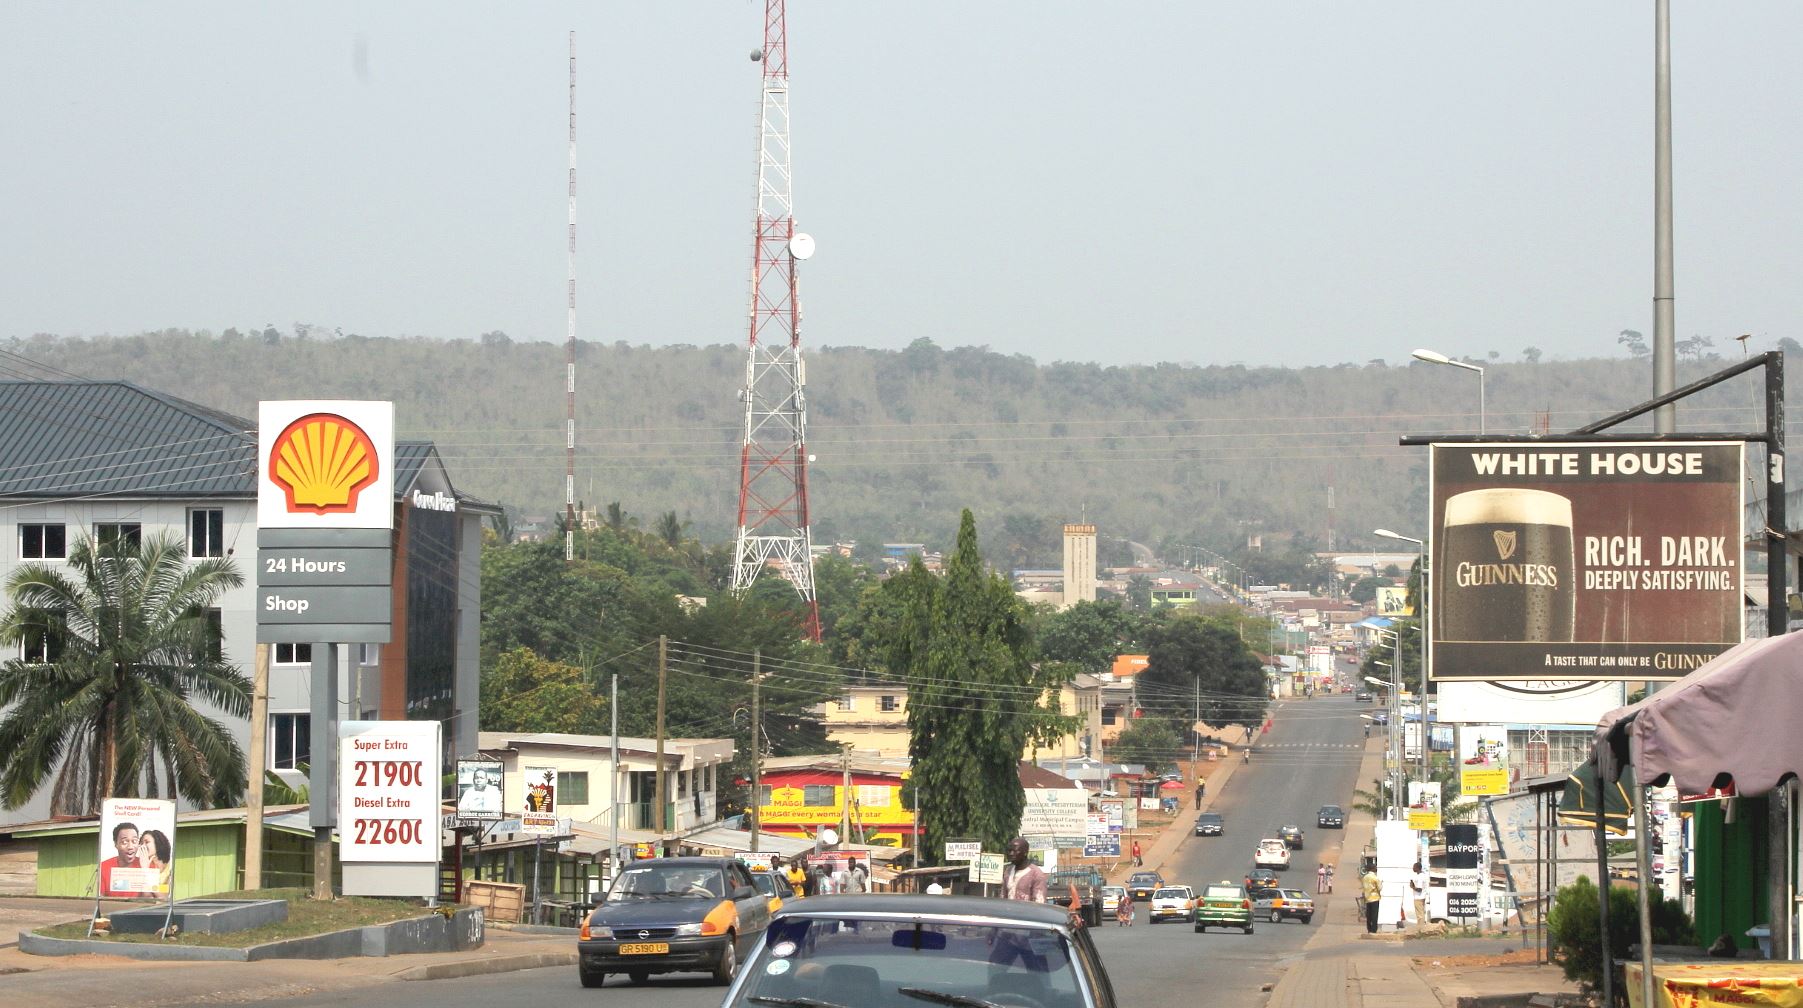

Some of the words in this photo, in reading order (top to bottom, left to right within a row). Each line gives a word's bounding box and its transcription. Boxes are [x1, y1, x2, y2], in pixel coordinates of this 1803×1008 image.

[1472, 453, 1578, 475] WHITE
[1590, 453, 1703, 475] HOUSE
[1585, 535, 1650, 567] RICH.
[1661, 535, 1735, 567] DARK.
[266, 558, 287, 573] 24
[291, 558, 346, 573] Hours
[1456, 561, 1558, 588] GUINNESS
[1585, 570, 1638, 590] DEEPLY
[1642, 570, 1735, 590] SATISFYING.
[265, 595, 309, 614] Shop
[1545, 654, 1551, 666] A
[1553, 656, 1576, 666] TASTE
[1577, 656, 1598, 666] THAT
[1600, 656, 1616, 666] CAN
[1618, 656, 1639, 666] ONLY
[1640, 656, 1650, 666] BE
[354, 739, 381, 752] Super
[384, 739, 408, 750] Extra
[354, 796, 384, 808] Diesel
[386, 797, 411, 808] Extra
[792, 811, 813, 819] every
[1448, 845, 1478, 853] BAYPOR
[621, 945, 633, 953] GR
